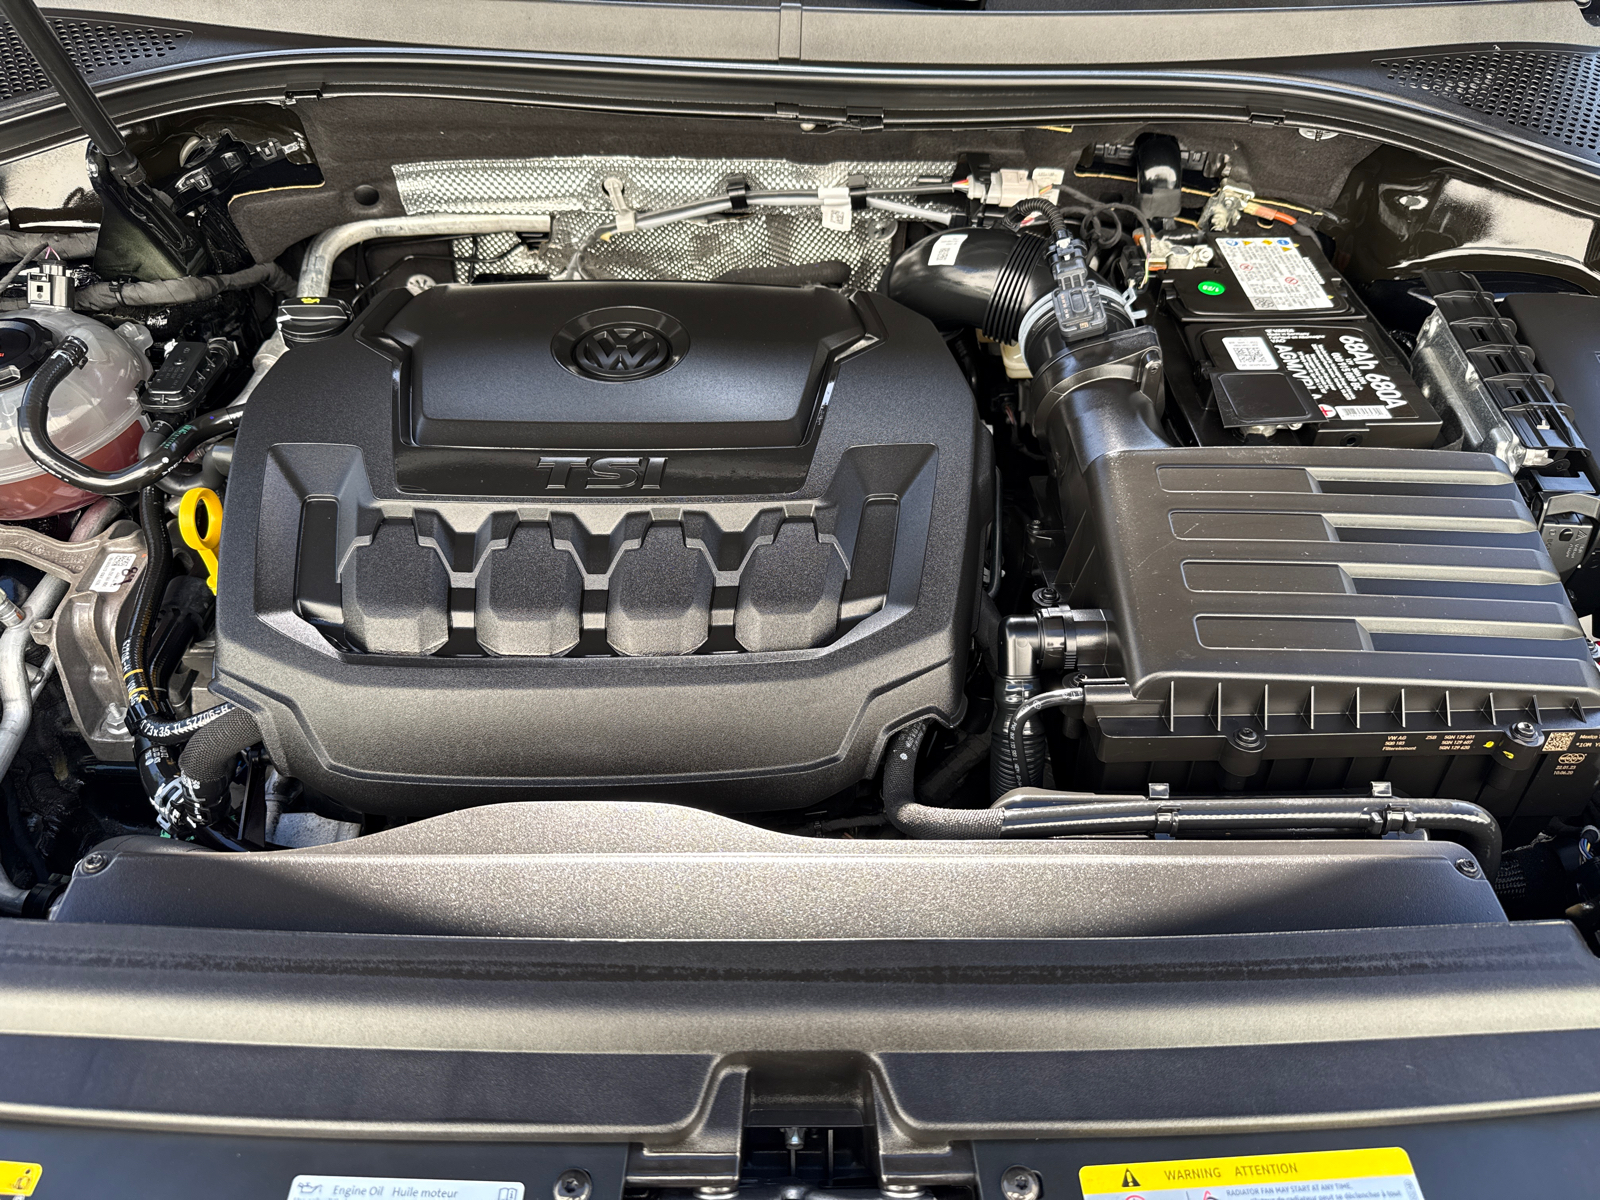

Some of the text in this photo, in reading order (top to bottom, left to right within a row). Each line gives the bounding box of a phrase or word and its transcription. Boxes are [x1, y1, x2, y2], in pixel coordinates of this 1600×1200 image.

[1338, 335, 1379, 370] 68Ah
[1364, 373, 1408, 410] 680A
[537, 456, 668, 489] TSI
[1164, 1162, 1298, 1181] WARNING ATTENTION
[333, 1185, 458, 1198] Engine Oil Huile moteur
[1226, 1187, 1259, 1196] RADIATOR
[1275, 1185, 1289, 1193] MAY
[1290, 1184, 1310, 1192] START
[1320, 1183, 1334, 1191] ANY
